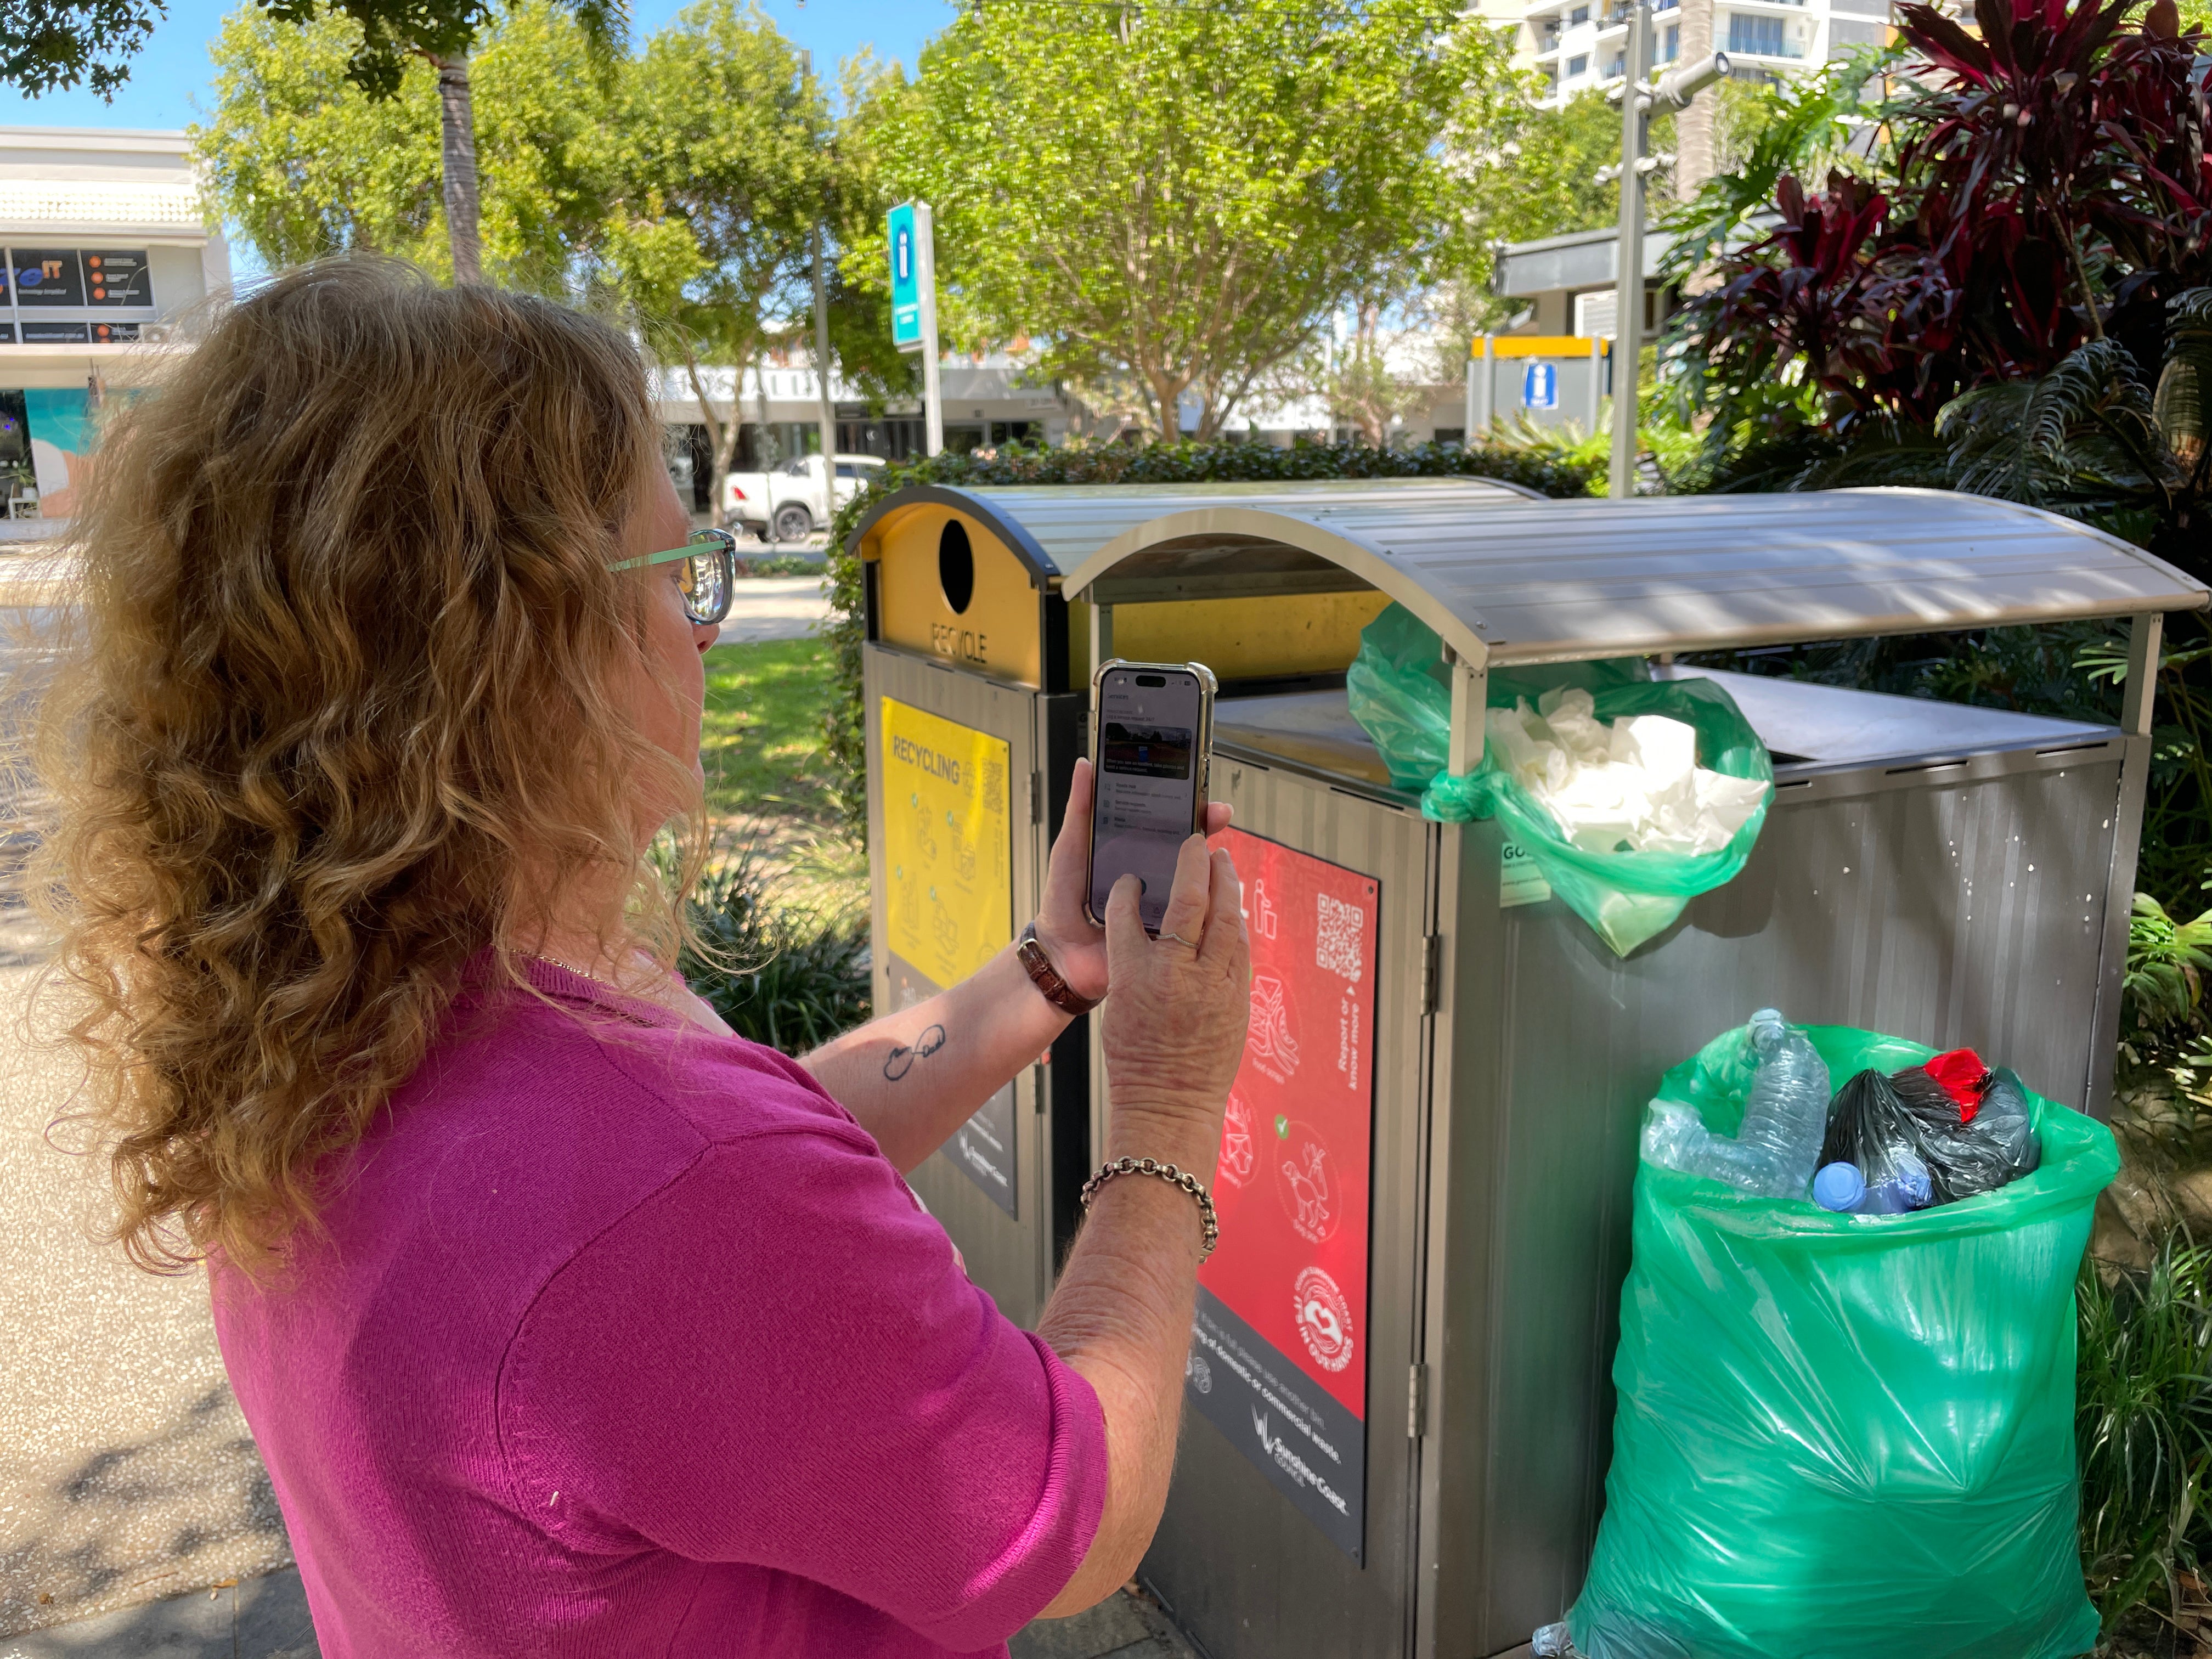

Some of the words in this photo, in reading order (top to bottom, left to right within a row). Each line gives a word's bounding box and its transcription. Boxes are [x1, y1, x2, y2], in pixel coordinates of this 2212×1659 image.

[932, 622, 987, 664] RECYCLE
[894, 735, 960, 786] RECYCLING
[1341, 996, 1349, 1015] or
[1351, 1003, 1359, 1045] more
[1338, 1018, 1350, 1072] Report
[1348, 1046, 1358, 1091] know
[1215, 1345, 1252, 1383] domestic
[1251, 1379, 1262, 1391] or
[1261, 1388, 1311, 1437] commercial
[1274, 1437, 1317, 1486] Sunshine
